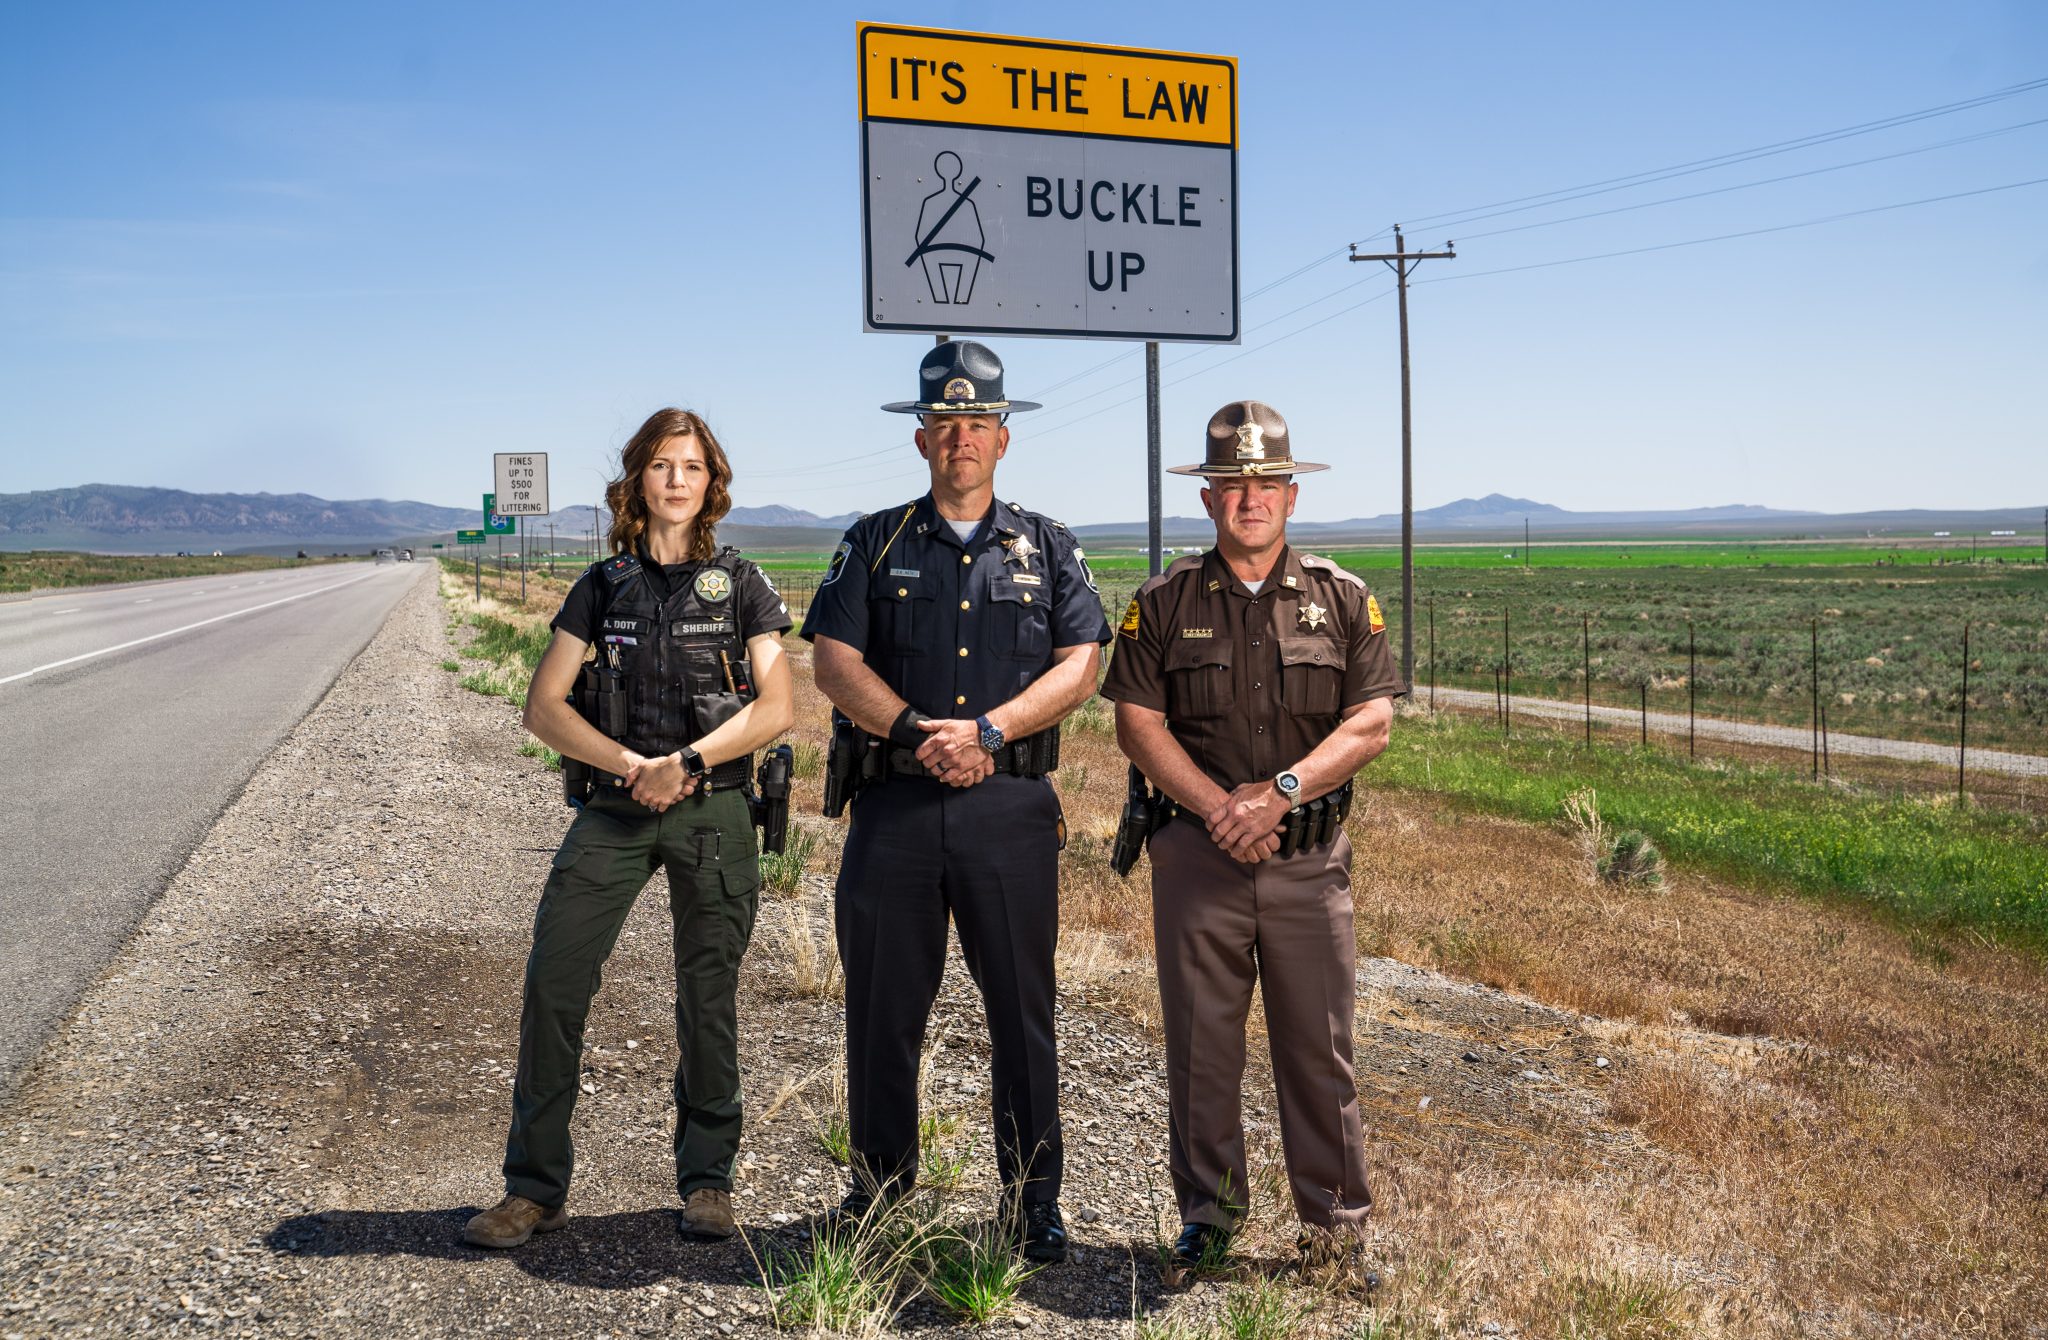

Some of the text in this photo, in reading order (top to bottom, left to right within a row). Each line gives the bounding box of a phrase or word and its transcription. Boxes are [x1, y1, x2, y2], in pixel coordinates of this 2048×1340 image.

[890, 57, 1209, 124] IT'S THE LAW
[1026, 175, 1201, 228] BUCKLE
[1088, 250, 1146, 292] UP
[509, 457, 532, 465] FINES
[509, 469, 534, 477] UP TO
[511, 480, 532, 489] $500
[514, 492, 530, 500] FOR
[502, 503, 541, 512] LITTERING
[491, 515, 507, 527] 84
[614, 620, 638, 630] DOTY
[682, 623, 725, 633] SHERIFF
